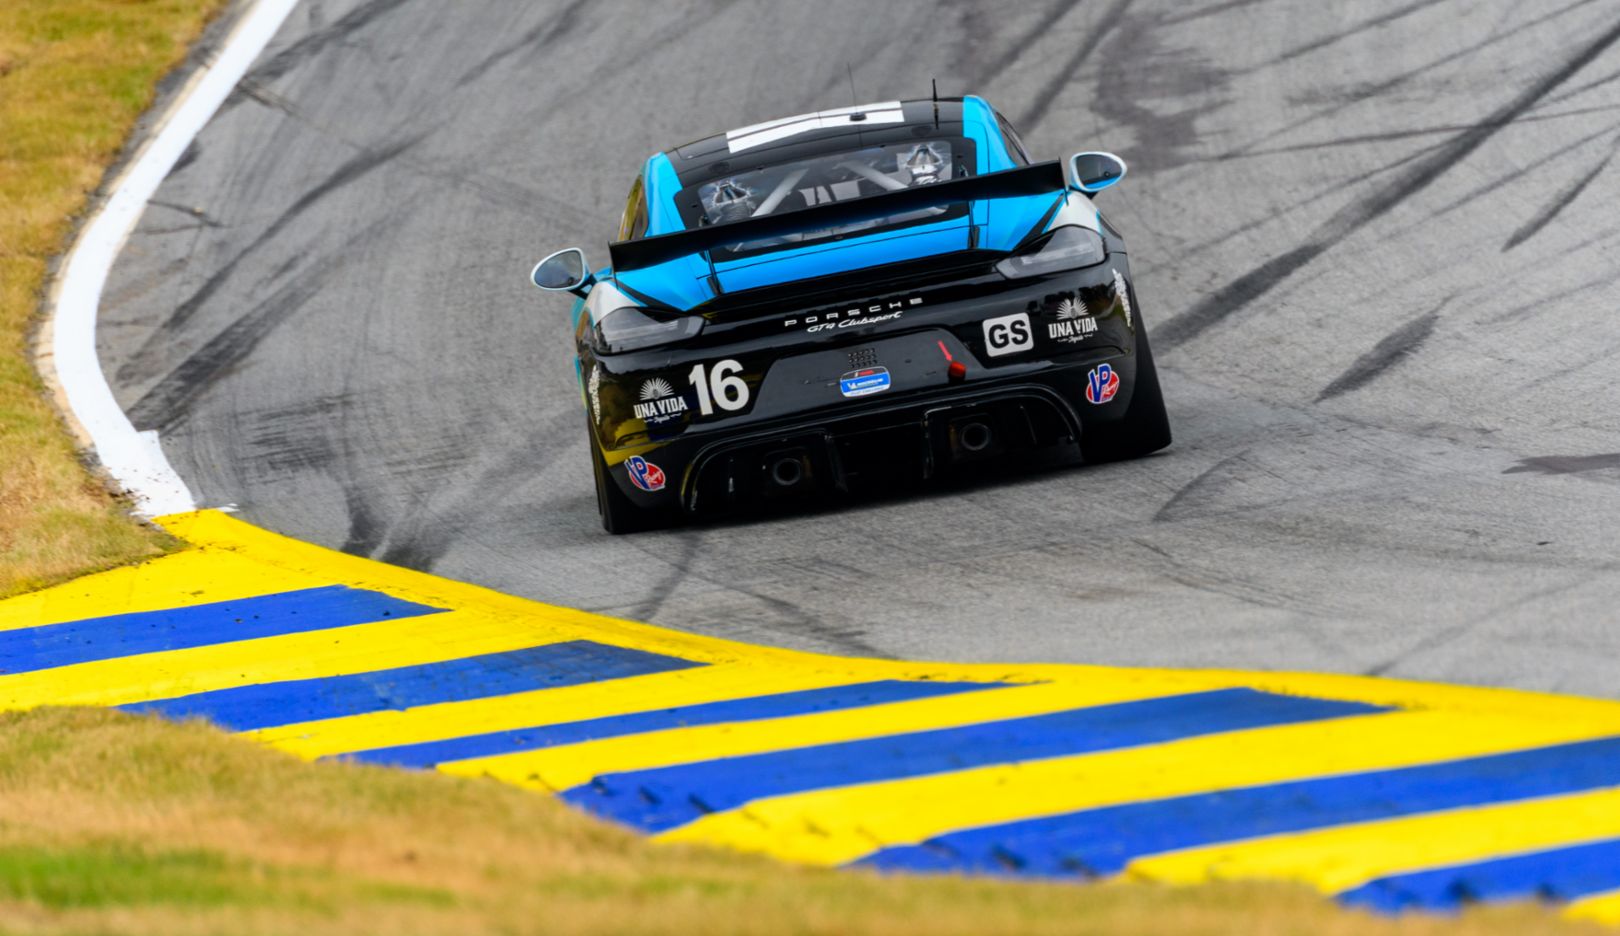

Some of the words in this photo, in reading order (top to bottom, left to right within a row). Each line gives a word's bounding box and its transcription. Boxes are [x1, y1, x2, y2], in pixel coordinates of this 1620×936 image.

[784, 297, 923, 327] PORSCHE
[806, 322, 836, 333] GT4
[837, 310, 903, 329] Clubsport
[988, 319, 1029, 349] GS
[1048, 320, 1075, 339] UNA
[1073, 316, 1098, 334] VIDA
[688, 359, 750, 416] 16
[1088, 363, 1112, 404] VP
[633, 401, 659, 419] UNA
[656, 395, 689, 414] VIDA
[624, 455, 650, 491] VP
